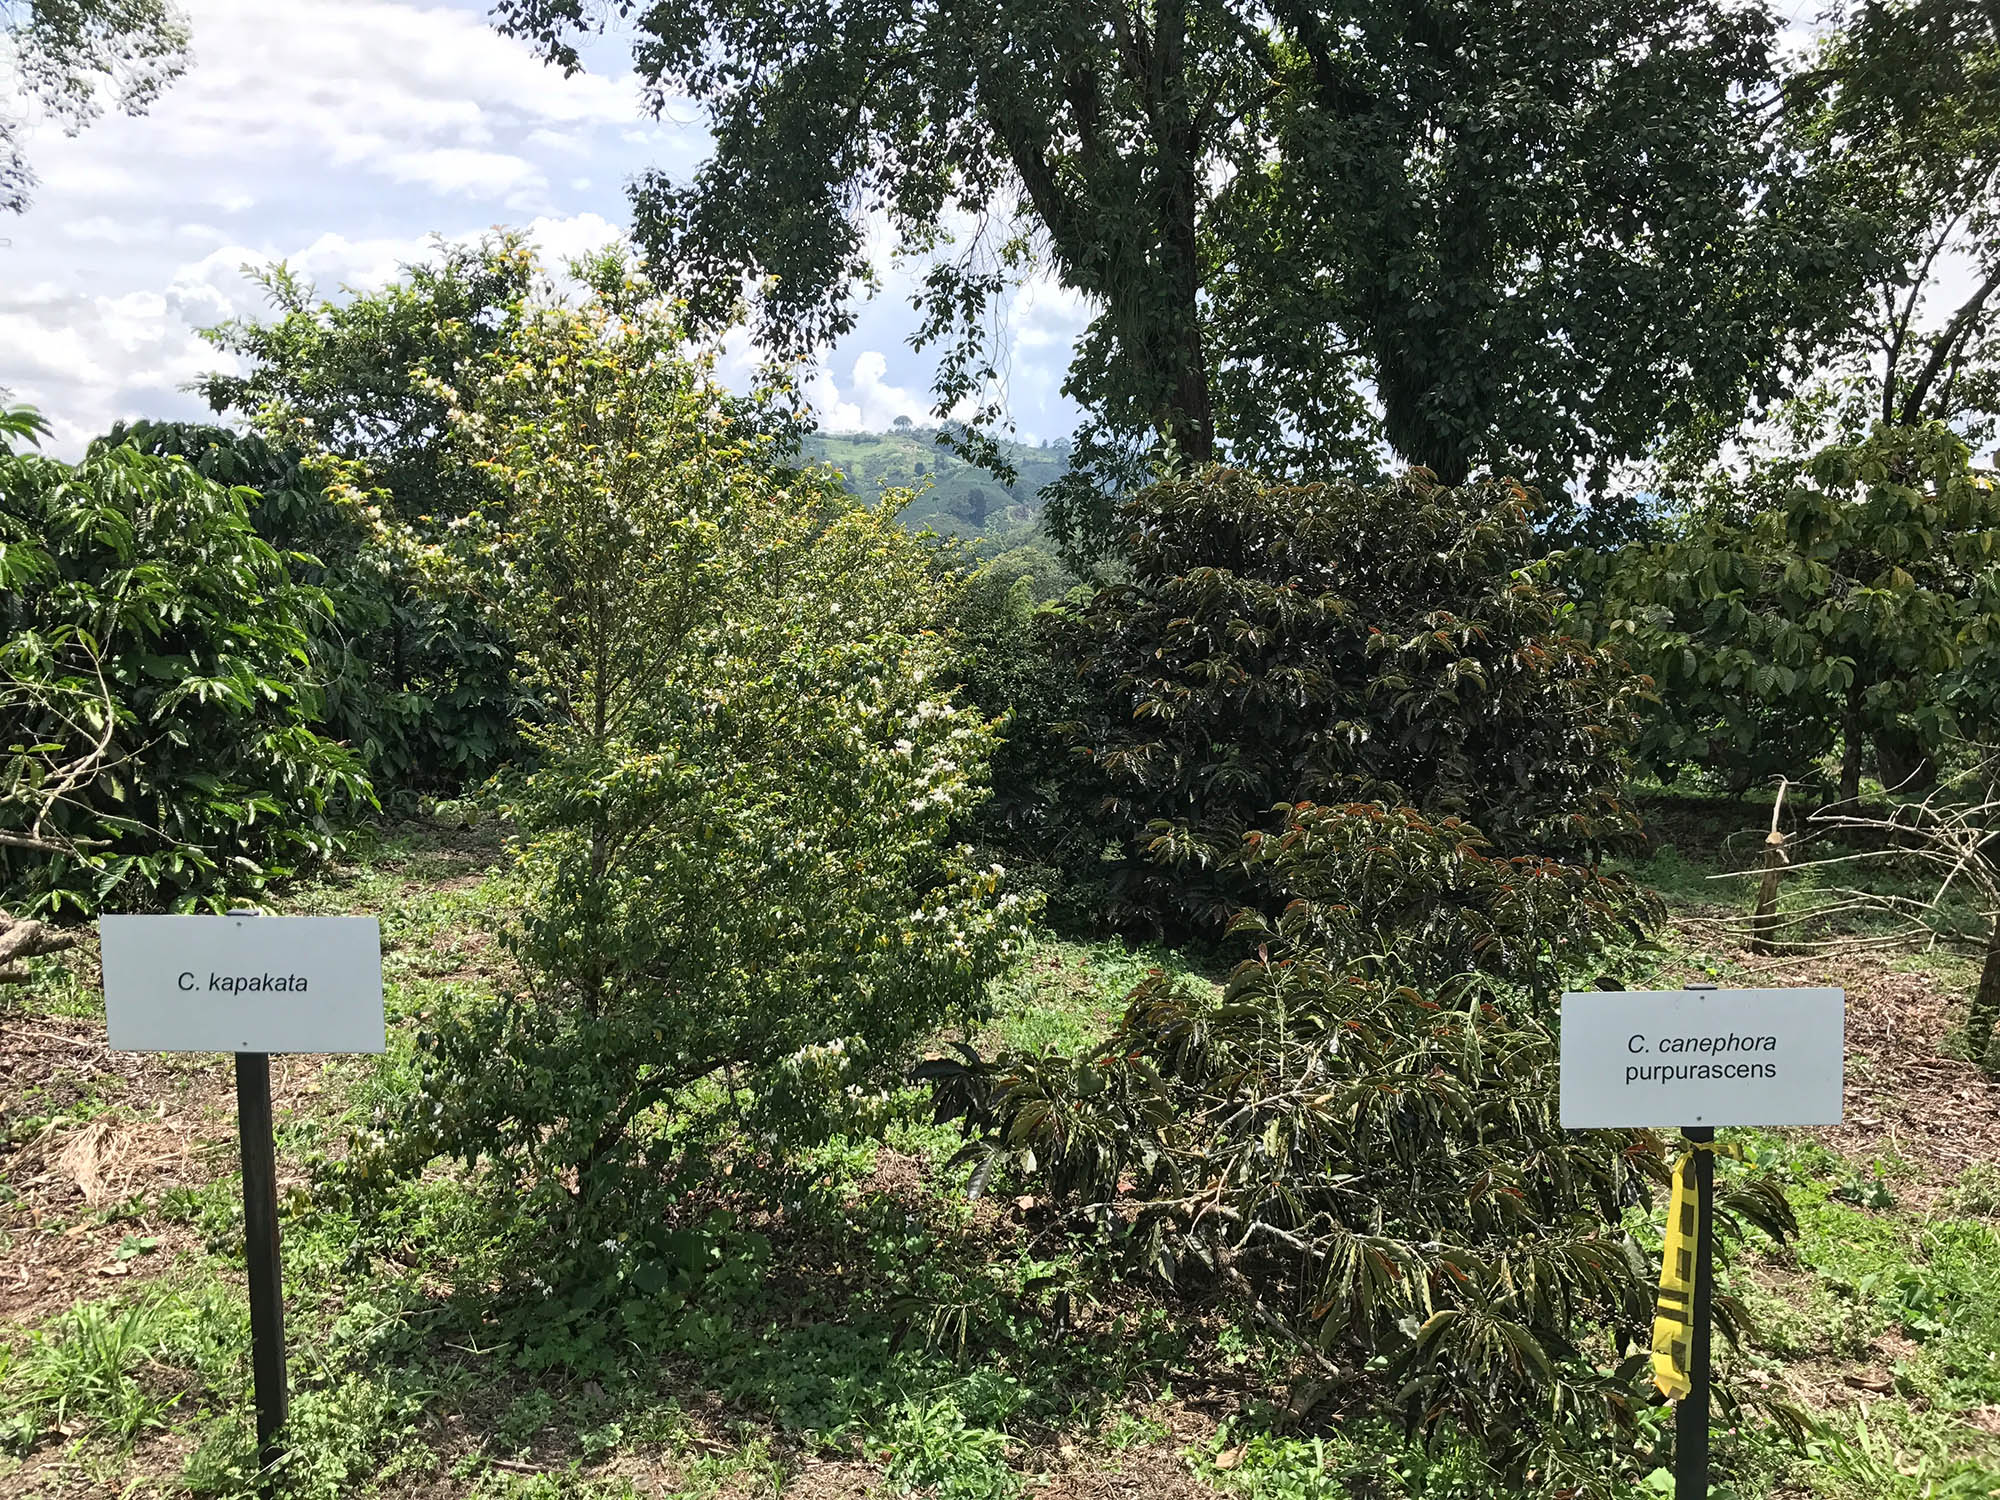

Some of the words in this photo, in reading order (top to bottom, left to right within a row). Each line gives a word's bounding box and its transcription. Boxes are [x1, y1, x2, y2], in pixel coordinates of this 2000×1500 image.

[177, 971, 200, 992] C.
[208, 972, 308, 996] kapakata
[1627, 1034, 1650, 1054] C.
[1658, 1032, 1777, 1057] canephora
[1625, 1063, 1777, 1085] purpurascens
